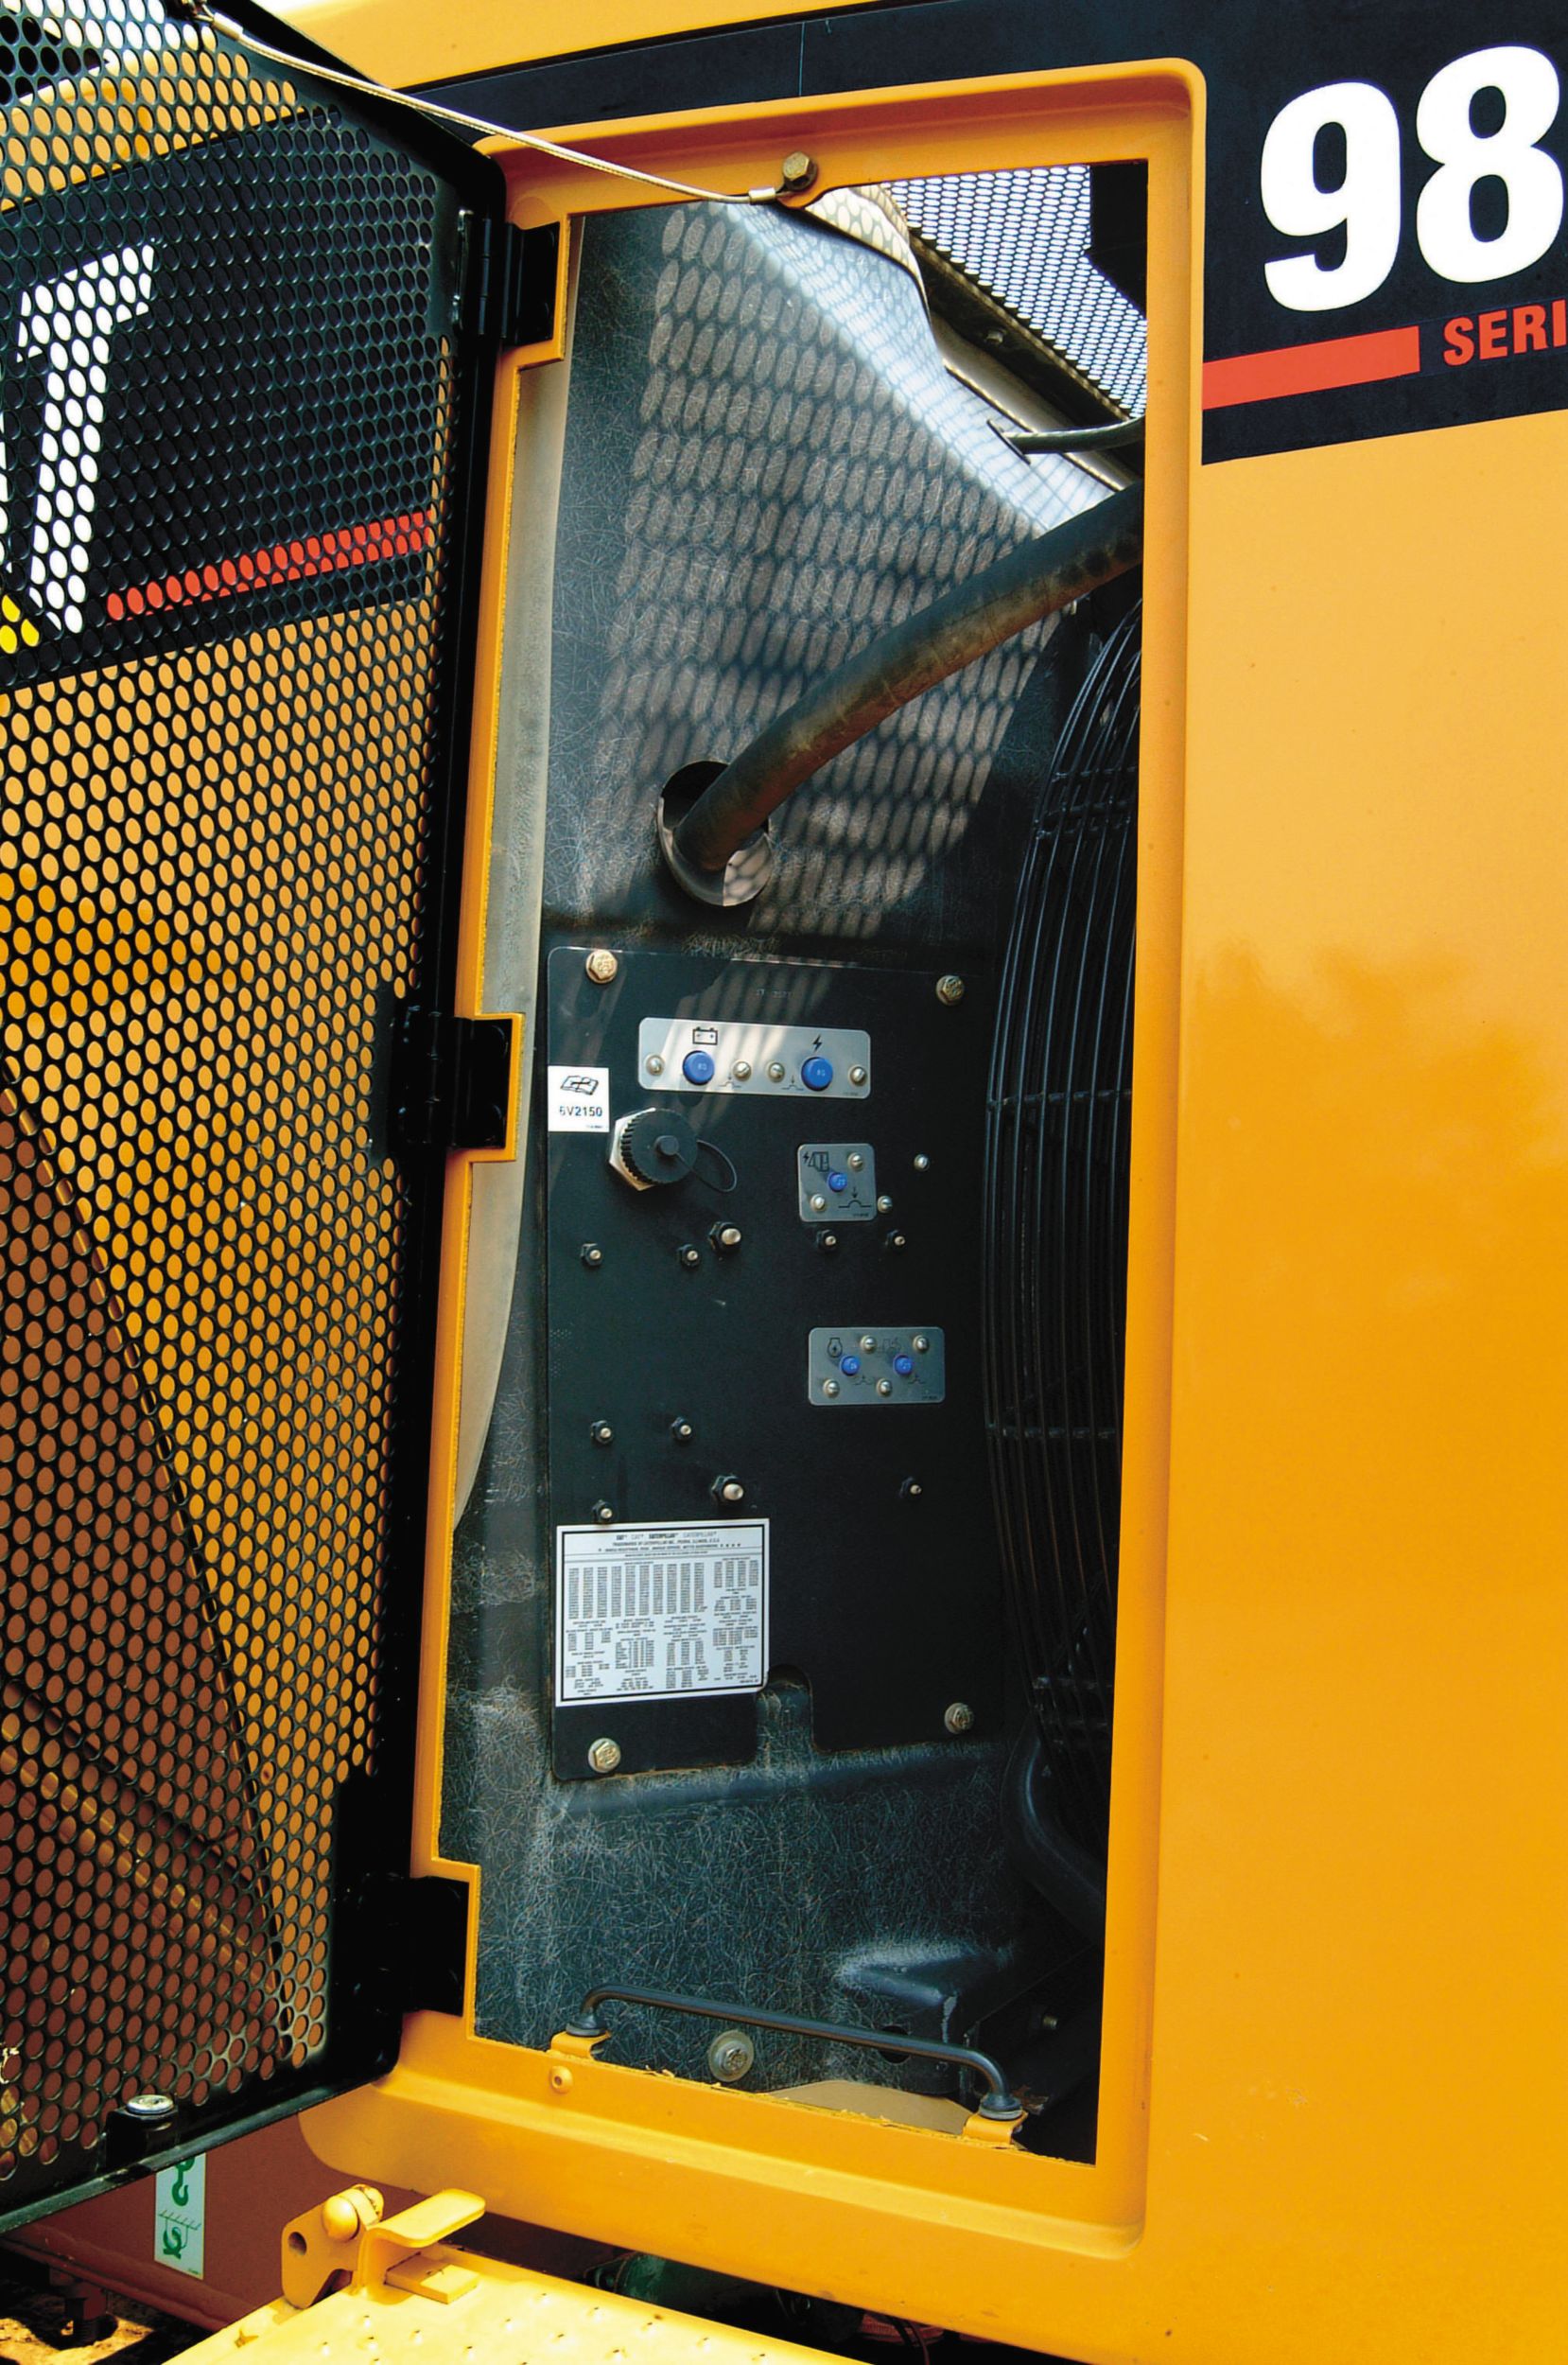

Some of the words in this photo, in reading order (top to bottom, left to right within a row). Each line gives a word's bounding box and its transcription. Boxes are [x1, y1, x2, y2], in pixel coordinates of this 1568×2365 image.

[1261, 44, 1564, 312] 98
[0, 244, 155, 633] T
[1442, 298, 1567, 367] SERI
